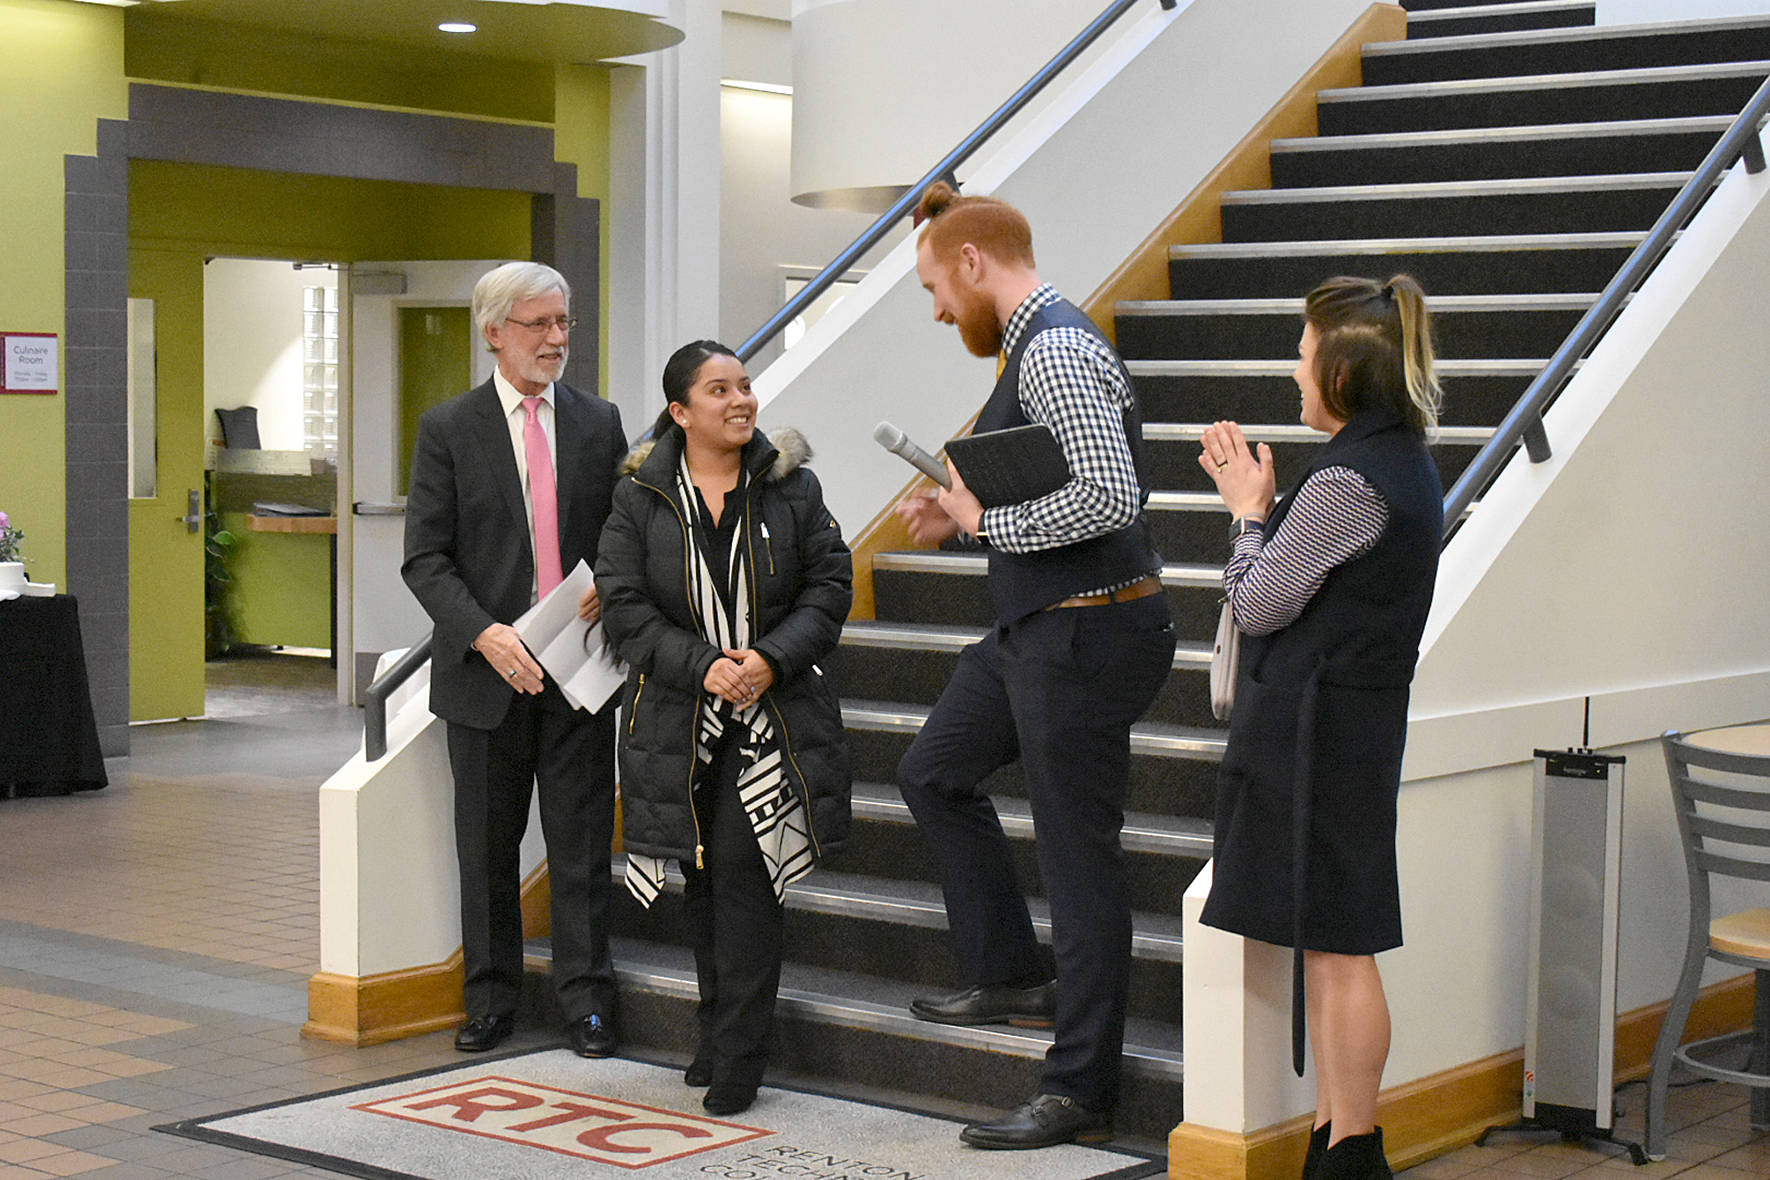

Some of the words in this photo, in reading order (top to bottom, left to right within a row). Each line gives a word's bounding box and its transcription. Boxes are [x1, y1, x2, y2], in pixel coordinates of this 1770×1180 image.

[18, 355, 44, 365] Room
[402, 1086, 714, 1153] RTC
[764, 1145, 926, 1180] RENTON
